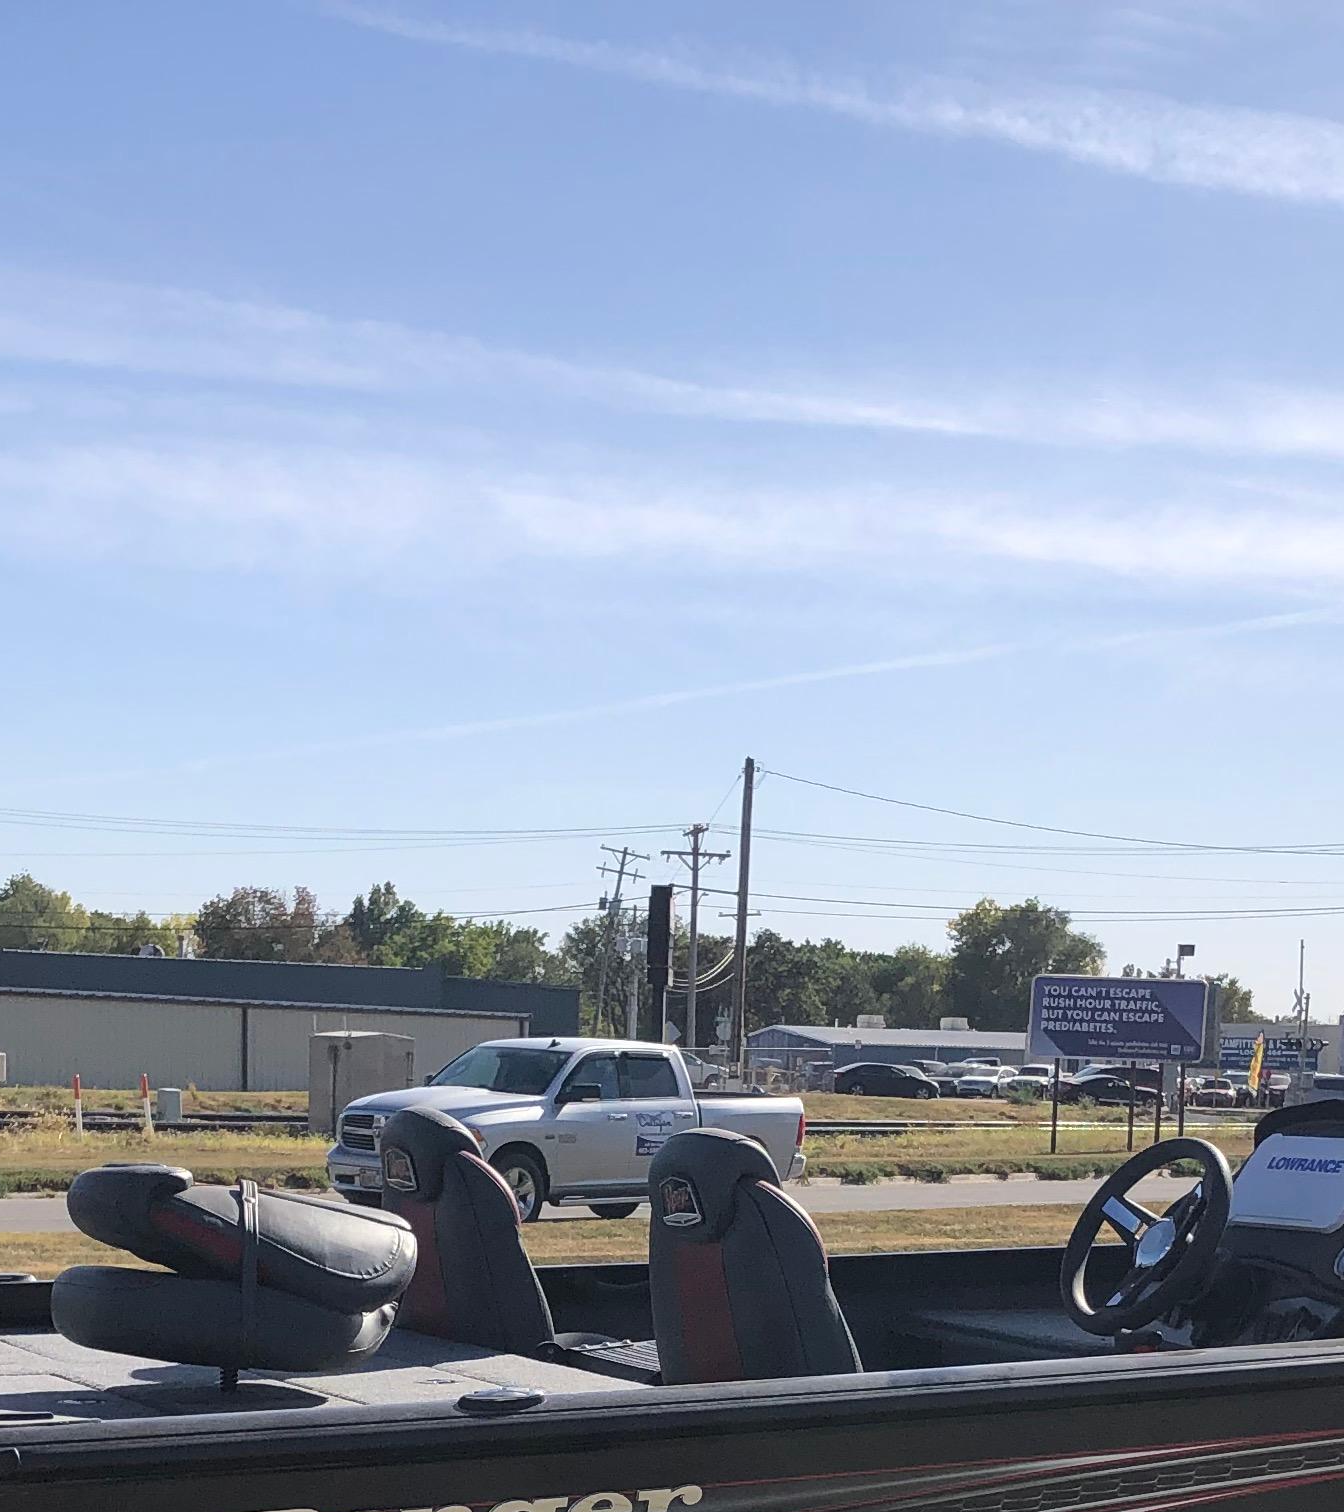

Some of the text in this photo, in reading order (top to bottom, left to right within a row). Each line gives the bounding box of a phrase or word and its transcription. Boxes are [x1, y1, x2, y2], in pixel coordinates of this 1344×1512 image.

[1043, 985, 1152, 999] YOU CAN'T ESCAPE
[1042, 997, 1162, 1012] RUSH HOUR TRAFFIC,
[1041, 1008, 1165, 1023] BUT YOU CAN ESCAPE
[1040, 1020, 1117, 1033] PREDIABETES.
